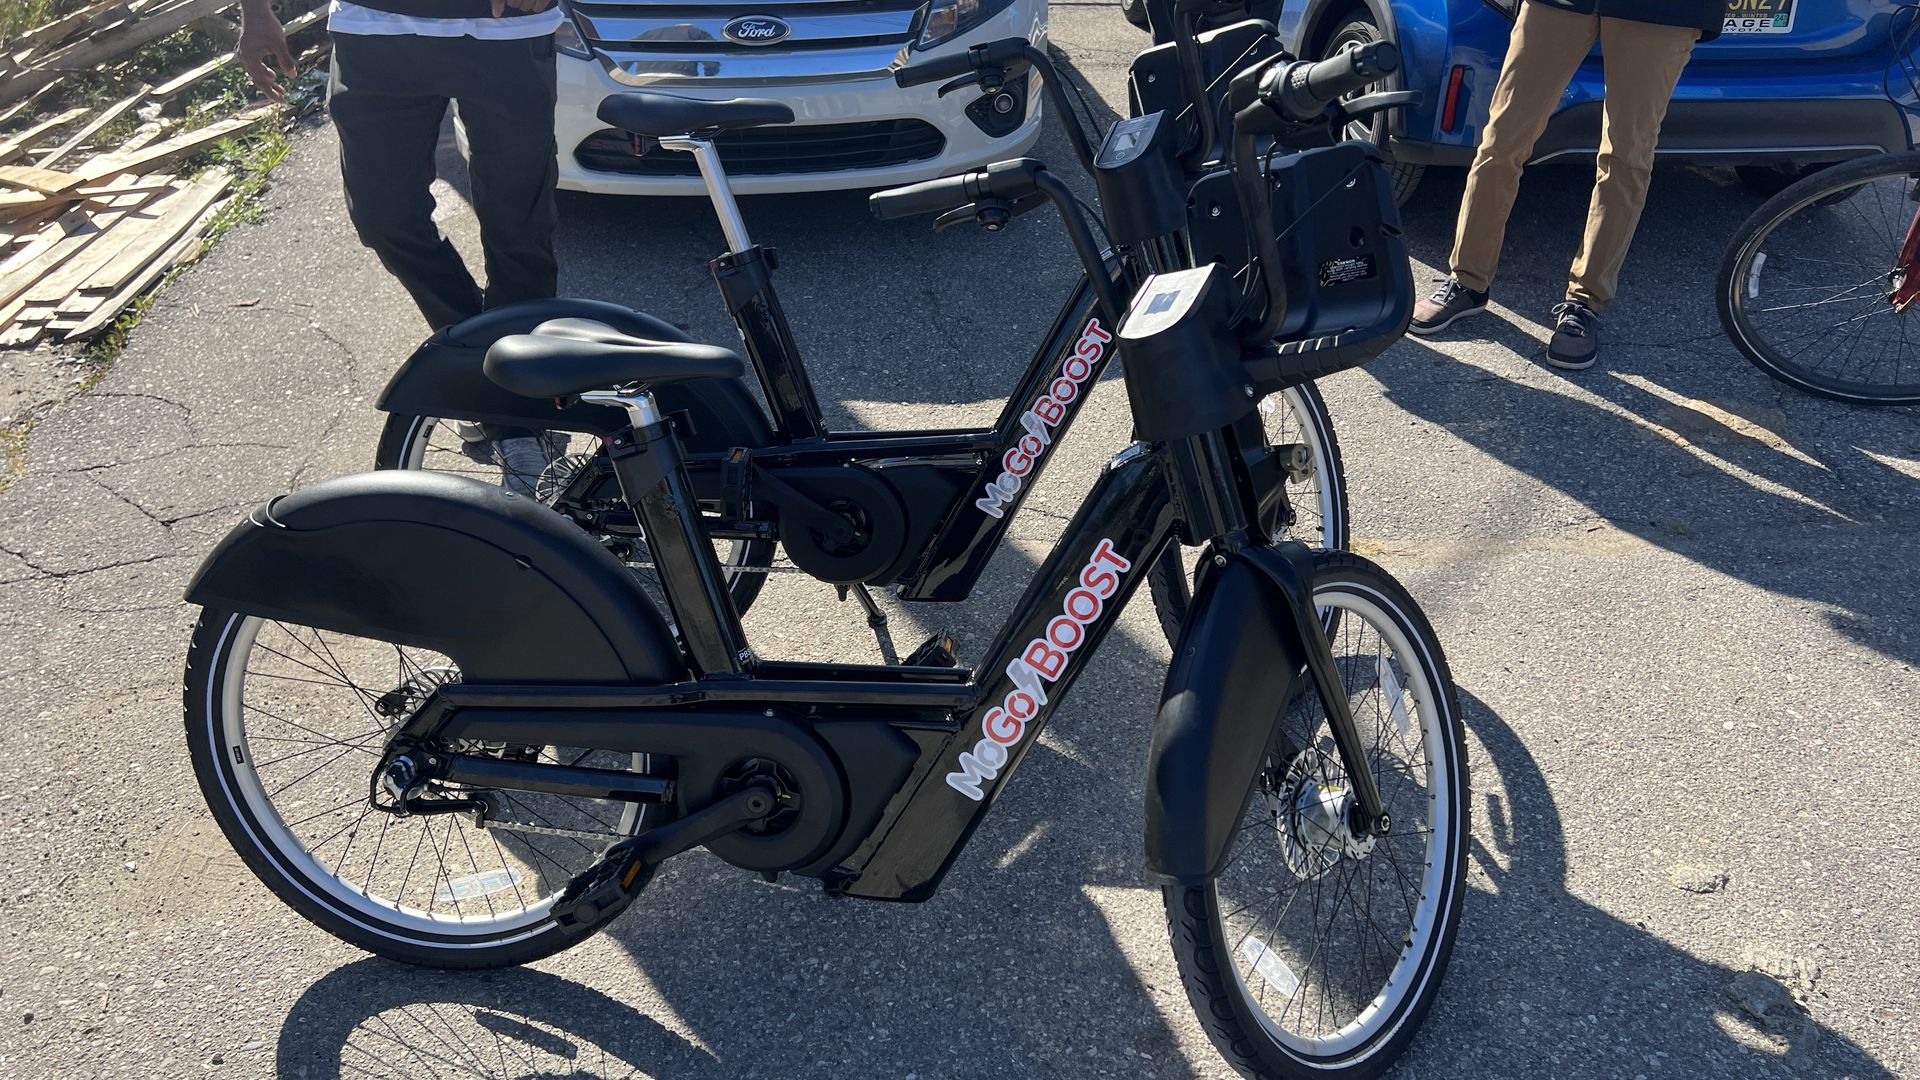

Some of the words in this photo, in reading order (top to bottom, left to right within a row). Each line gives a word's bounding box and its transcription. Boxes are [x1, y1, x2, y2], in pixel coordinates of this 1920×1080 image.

[738, 21, 776, 38] Ford
[1031, 318, 1112, 427] BOOST
[1021, 538, 1131, 682] BOOST
